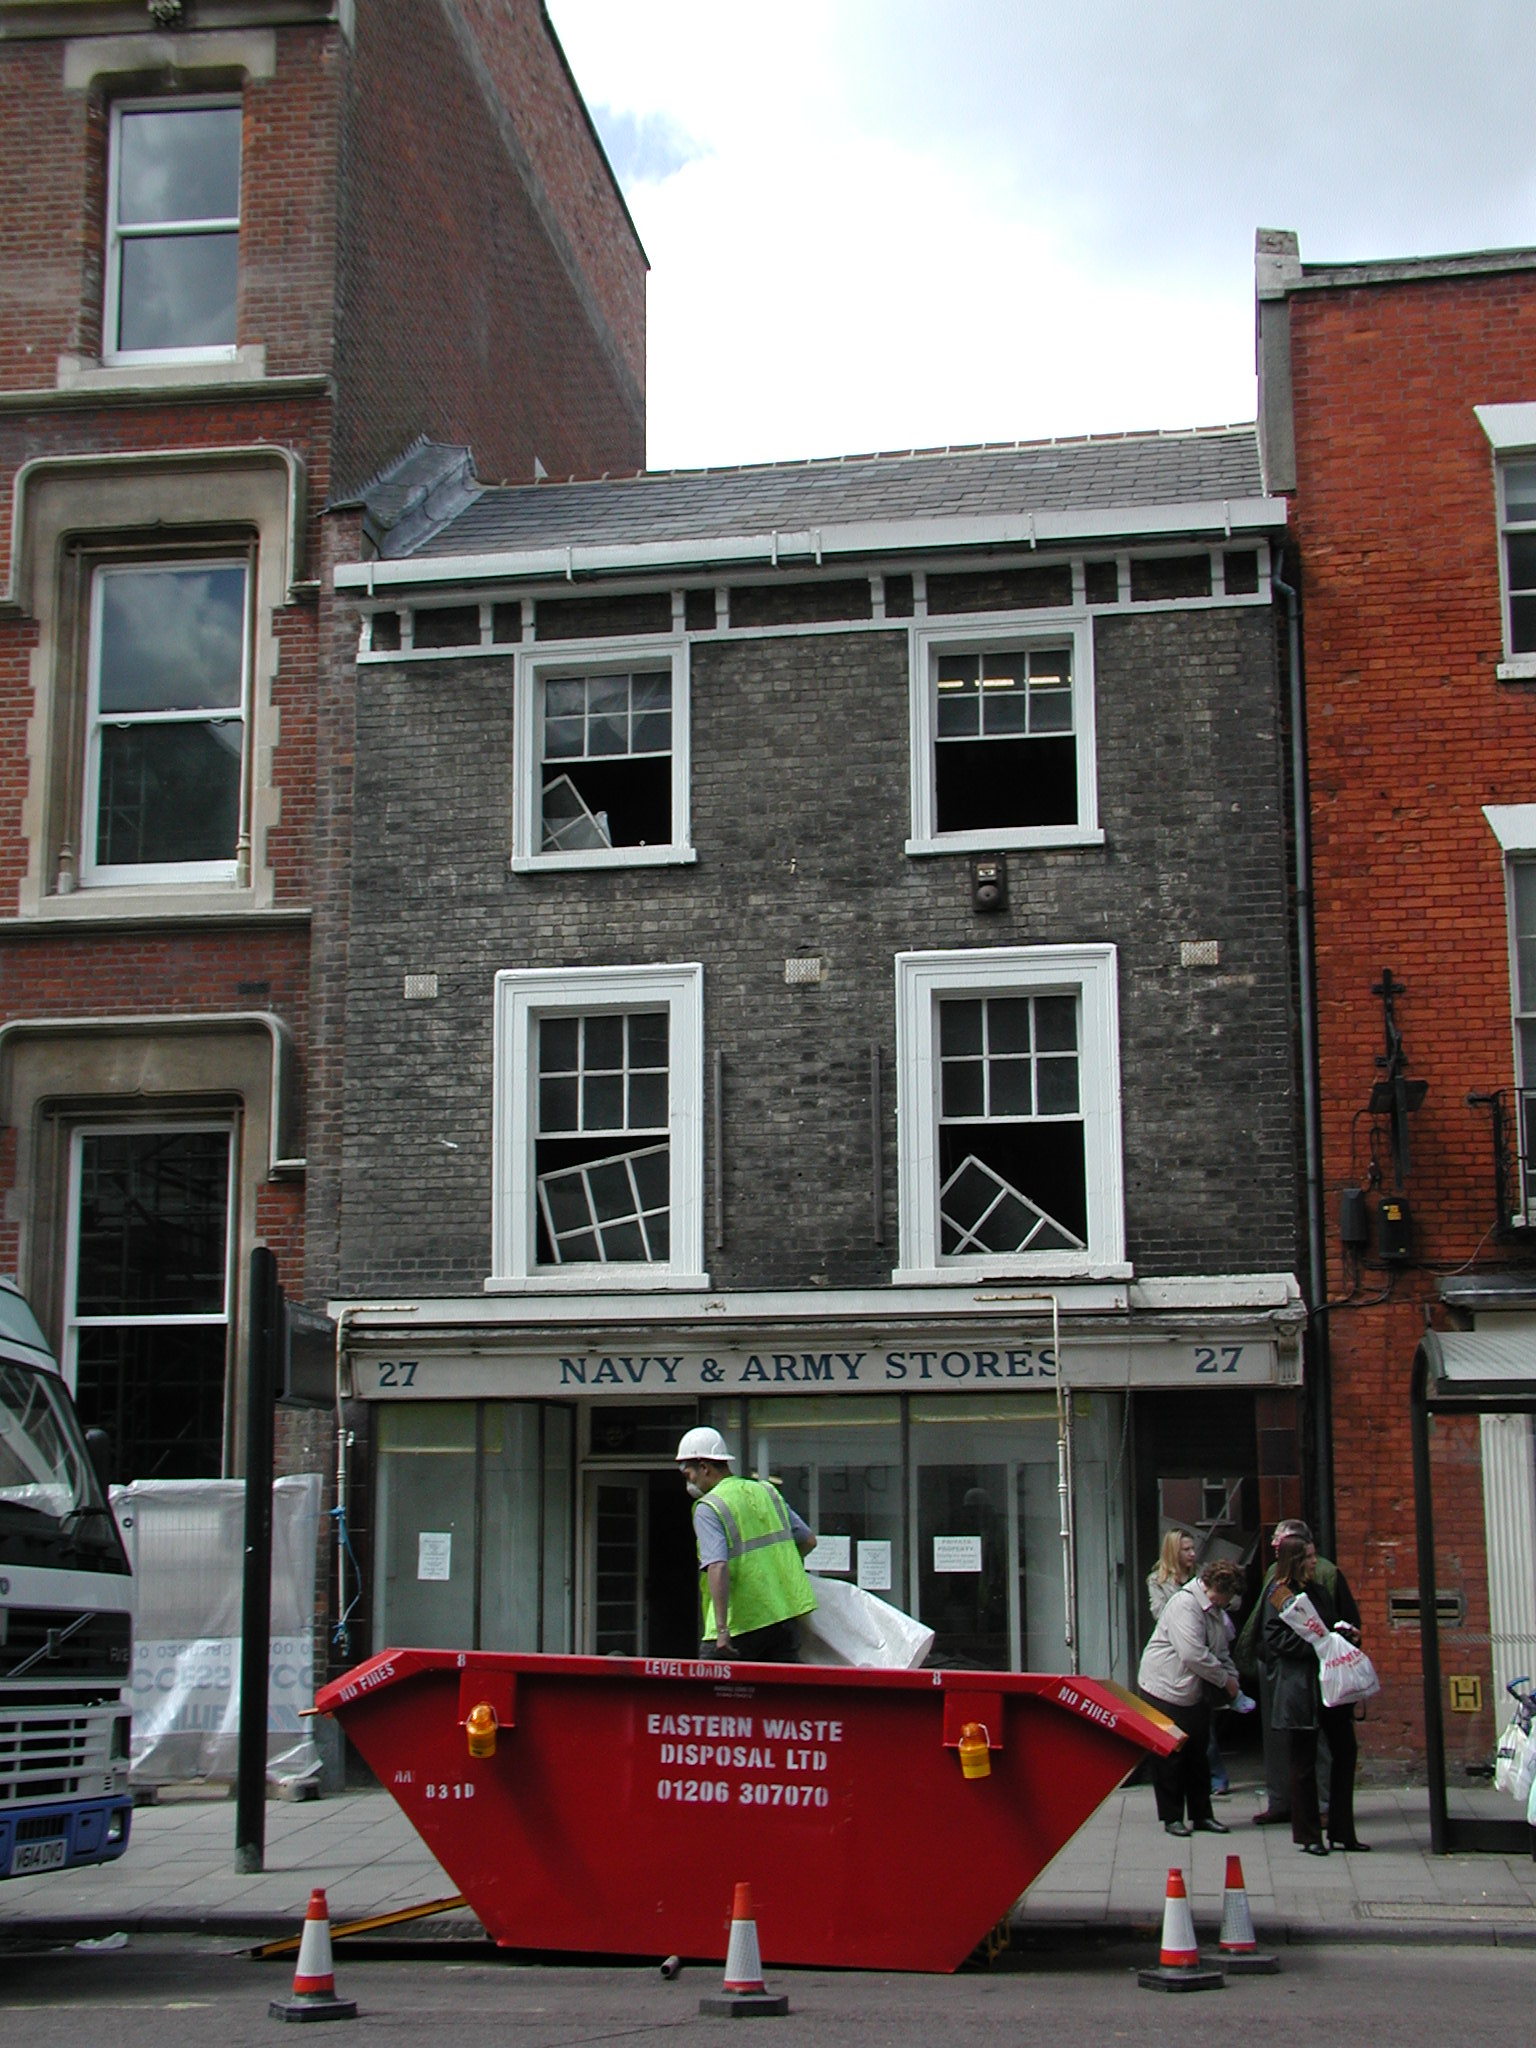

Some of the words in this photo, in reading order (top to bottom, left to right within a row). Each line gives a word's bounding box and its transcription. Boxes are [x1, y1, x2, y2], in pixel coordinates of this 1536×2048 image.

[559, 1355, 685, 1385] NAVY
[699, 1357, 725, 1383] &
[738, 1352, 867, 1381] ARMY
[885, 1348, 1063, 1379] STORES
[1194, 1346, 1244, 1373] 27
[378, 1361, 419, 1387] 27
[456, 1653, 466, 1668] 8
[645, 1660, 684, 1677] LEVEL
[688, 1663, 731, 1679] LOADS
[338, 1684, 358, 1703] NO
[359, 1662, 396, 1691] FIRES
[932, 1670, 942, 1686] 8
[1057, 1685, 1079, 1706] NO
[1079, 1698, 1119, 1729] FIRES
[1454, 1680, 1478, 1708] H
[647, 1713, 753, 1738] EASTERN
[763, 1718, 844, 1742] WASTE
[660, 1743, 776, 1768] DISPOSAL
[786, 1748, 828, 1771] LTD
[657, 1779, 730, 1803] 01206
[739, 1782, 830, 1808] 307070
